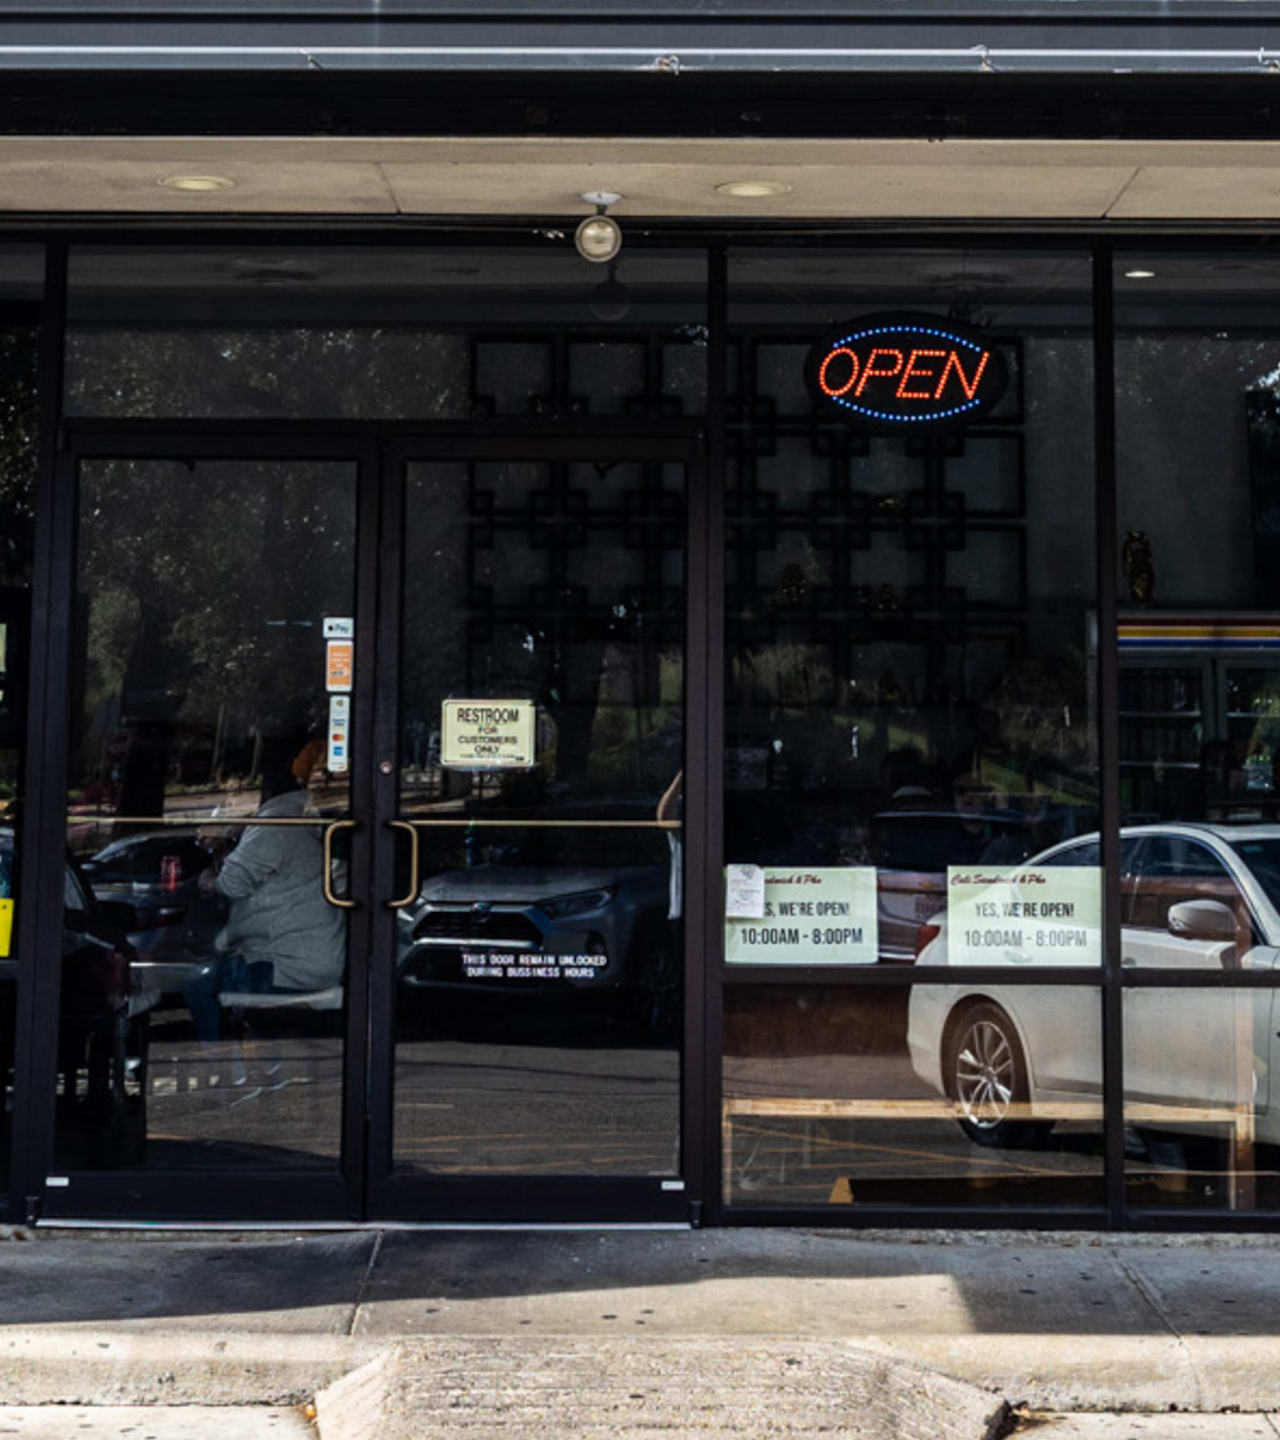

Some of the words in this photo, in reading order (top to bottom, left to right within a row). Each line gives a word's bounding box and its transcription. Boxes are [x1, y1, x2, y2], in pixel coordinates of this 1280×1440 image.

[819, 346, 990, 400] OPEN
[457, 707, 519, 723] RESTROOM
[478, 726, 498, 735] FOR
[458, 735, 518, 745] CUSTOMERS
[474, 744, 500, 753] ONLY
[779, 902, 813, 916] WE'RE
[816, 902, 850, 916] OPEN!
[976, 903, 1000, 918] YES,
[1040, 902, 1074, 917] OPEN!
[741, 928, 799, 945] 10:00AM
[812, 928, 863, 945] 8:00PM
[966, 931, 1022, 946] 10:00AM
[1036, 930, 1087, 947] 8:00PM
[462, 954, 486, 964] THIS
[489, 954, 515, 965] DOOR
[519, 954, 555, 965] REMAIN
[559, 954, 608, 965] UNLOCKED
[467, 967, 503, 977] DURING
[507, 967, 560, 977] BUSSINESS
[564, 967, 594, 978] HOURS
